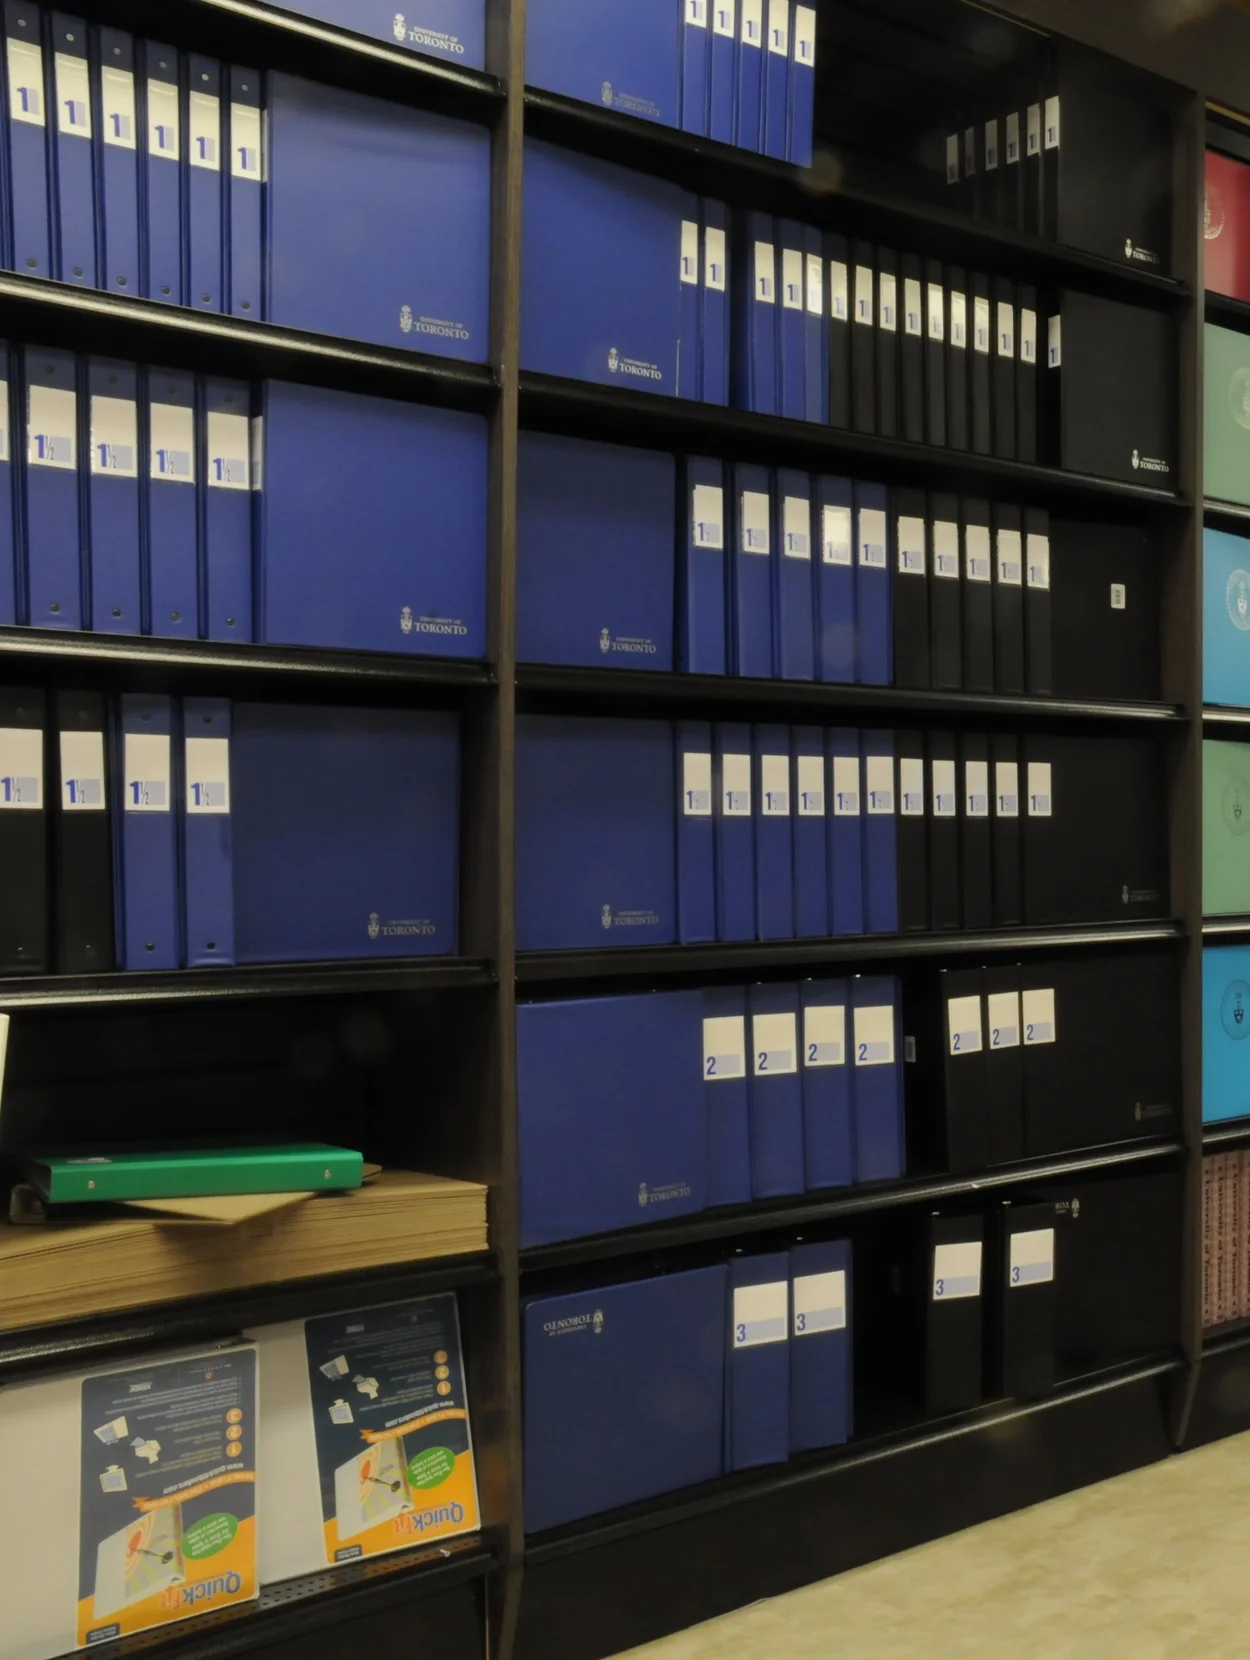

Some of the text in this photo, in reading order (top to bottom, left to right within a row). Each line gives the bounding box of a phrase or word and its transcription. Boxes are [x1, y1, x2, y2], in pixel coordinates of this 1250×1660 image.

[408, 31, 465, 54] TORONTO
[17, 87, 29, 112] 1
[614, 97, 660, 116] TORONTO
[64, 100, 76, 125] 1
[109, 113, 121, 138] 1
[155, 125, 165, 149] 1
[196, 136, 206, 160] 1
[238, 147, 248, 170] 1
[413, 321, 469, 340] TORONTO
[619, 362, 662, 379] TORONTO
[1140, 461, 1170, 472] TORONTO
[414, 622, 467, 636] TORONTO
[611, 642, 657, 653] TORONTO
[383, 925, 436, 936] TORONTO
[613, 916, 659, 926] TORONTO
[992, 1028, 1000, 1047] 2
[1026, 1023, 1034, 1041] 2
[952, 1033, 961, 1051] 2
[758, 1051, 768, 1071] 2
[808, 1043, 818, 1063] 2
[858, 1042, 868, 1062] 2
[706, 1056, 717, 1076] 2
[649, 1187, 691, 1203] TORONTO
[1011, 1265, 1021, 1285] 3
[935, 1278, 945, 1297] 3
[544, 1314, 592, 1331] TORONTO
[796, 1312, 806, 1333] 3
[736, 1322, 747, 1344] 3
[438, 1367, 445, 1377] 2
[231, 1427, 238, 1438] 2
